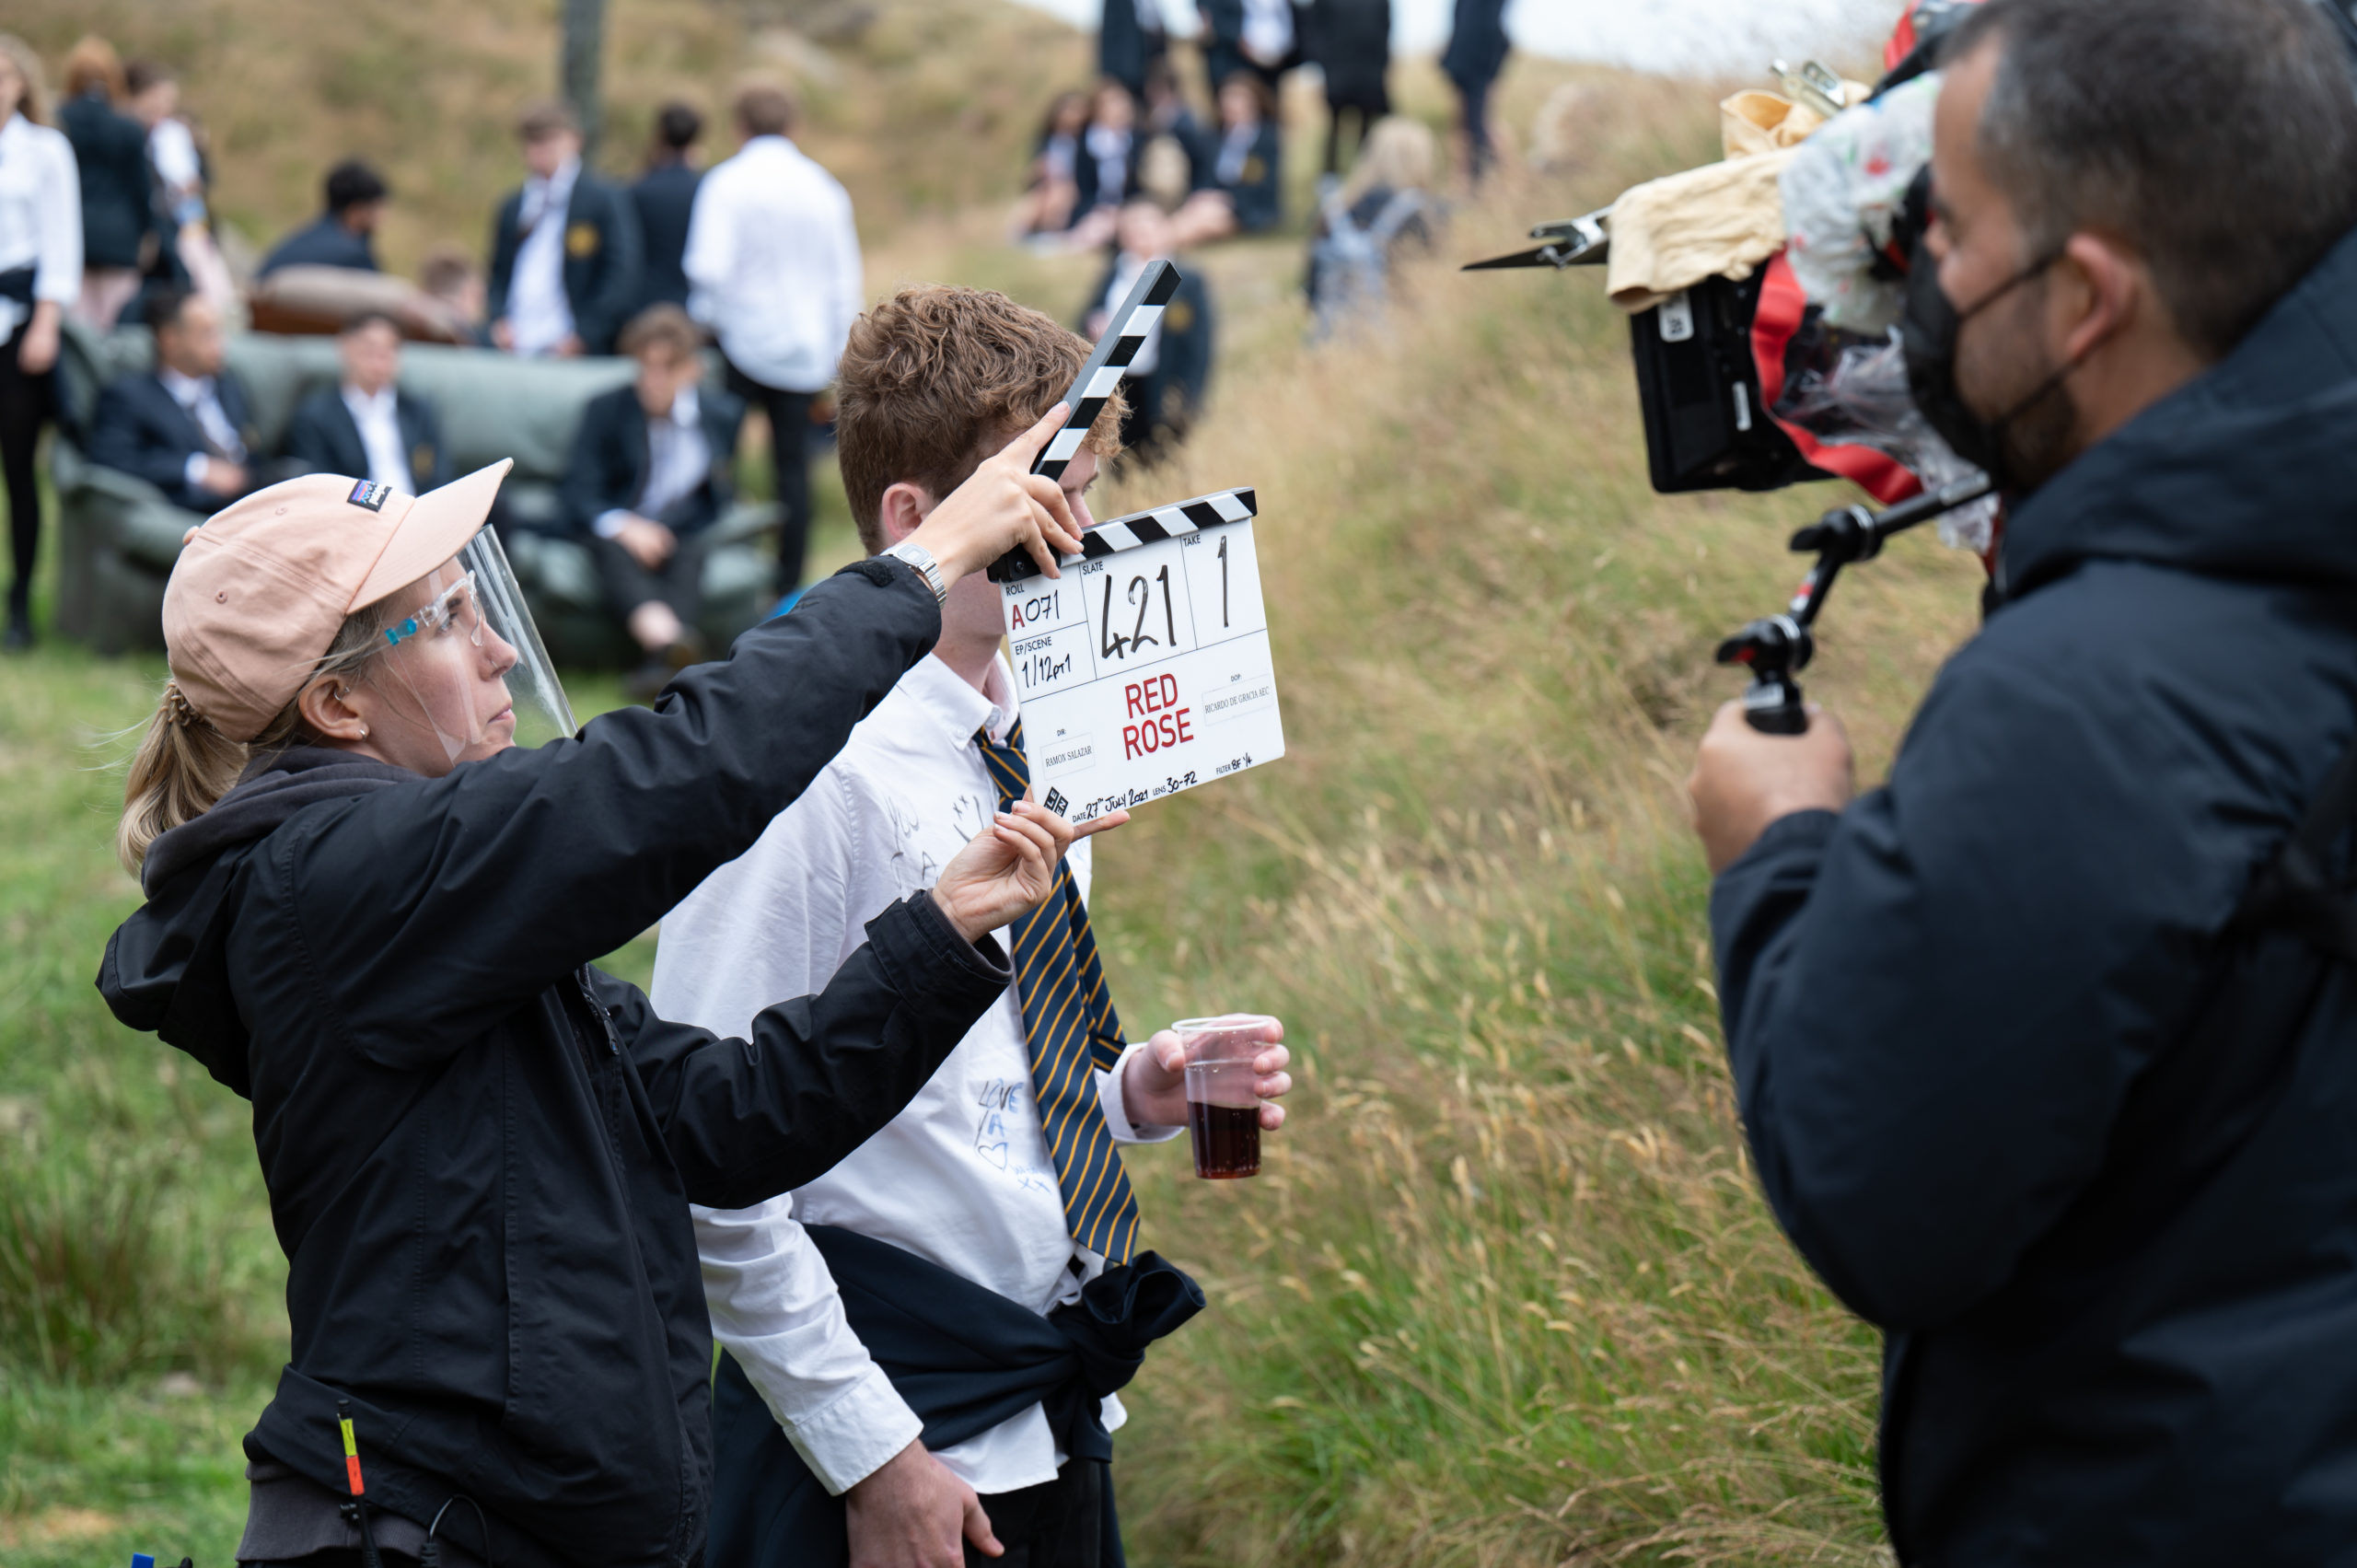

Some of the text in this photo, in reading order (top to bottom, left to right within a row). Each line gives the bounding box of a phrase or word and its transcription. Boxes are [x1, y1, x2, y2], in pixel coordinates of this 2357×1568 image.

[1183, 534, 1201, 547] TAKE
[1082, 561, 1104, 575] SLATE
[1005, 583, 1025, 597] ROLL
[1217, 535, 1229, 628] 1
[1101, 564, 1177, 659] 421
[1015, 636, 1052, 656] EP/SCENE
[1124, 673, 1178, 719] RED
[1204, 698, 1229, 714] RICARDO
[1229, 696, 1238, 706] DE
[1238, 689, 1259, 703] GRACIA
[1122, 707, 1194, 761] ROSE
[1045, 745, 1093, 768] RAMON SALAZAR
[1215, 764, 1231, 775] FILTER
[1152, 771, 1198, 796] LENS 30-72
[1072, 811, 1086, 823] DATE
[1105, 796, 1127, 812] JULY
[1129, 788, 1149, 806] 2021
[978, 1077, 1024, 1113] LOVE
